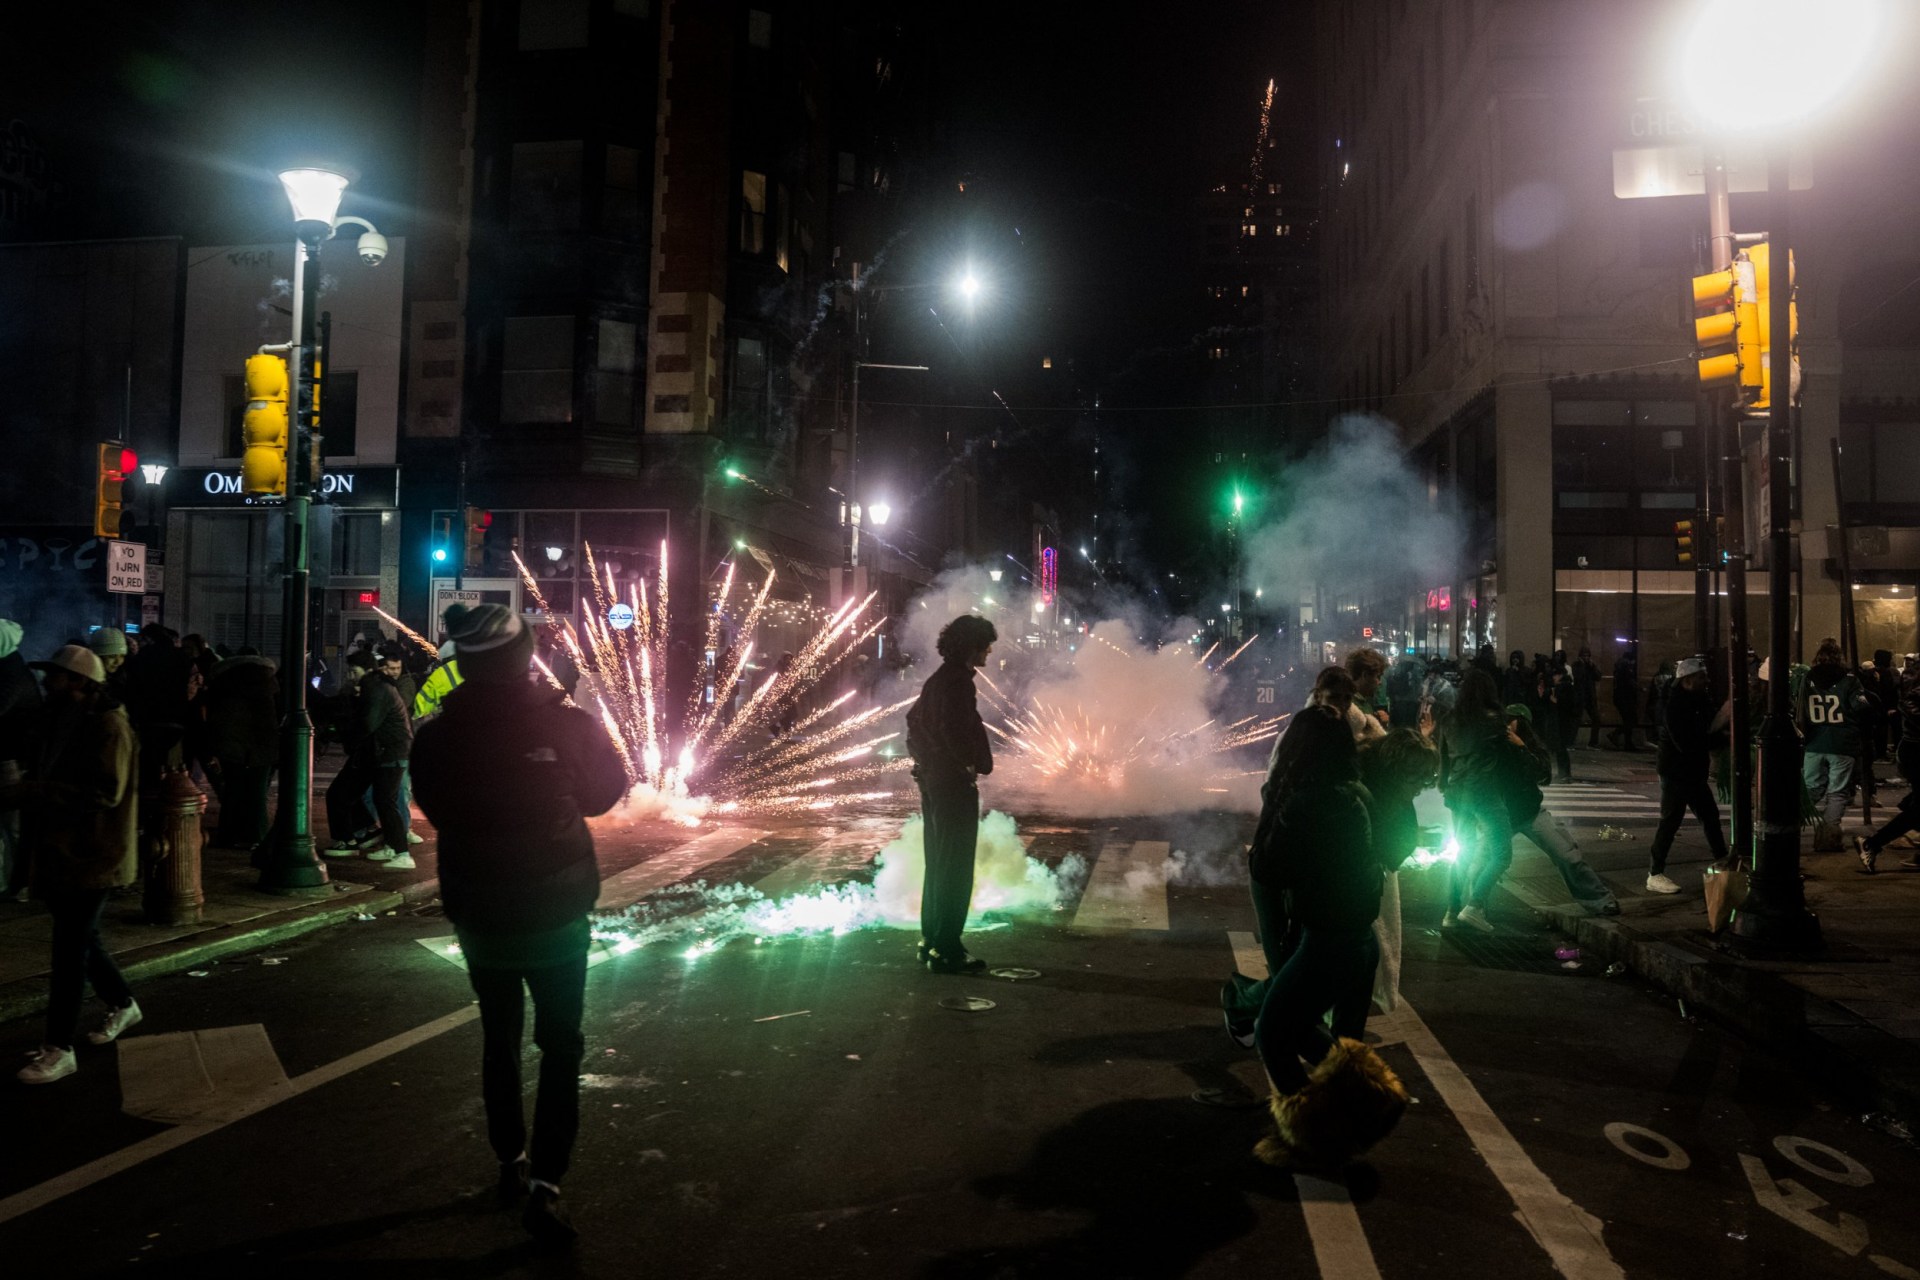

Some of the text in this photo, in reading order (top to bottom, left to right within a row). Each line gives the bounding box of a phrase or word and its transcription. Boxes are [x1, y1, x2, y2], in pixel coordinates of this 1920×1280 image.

[127, 577, 143, 588] RED
[1256, 687, 1275, 703] 20
[1808, 694, 1844, 723] 62
